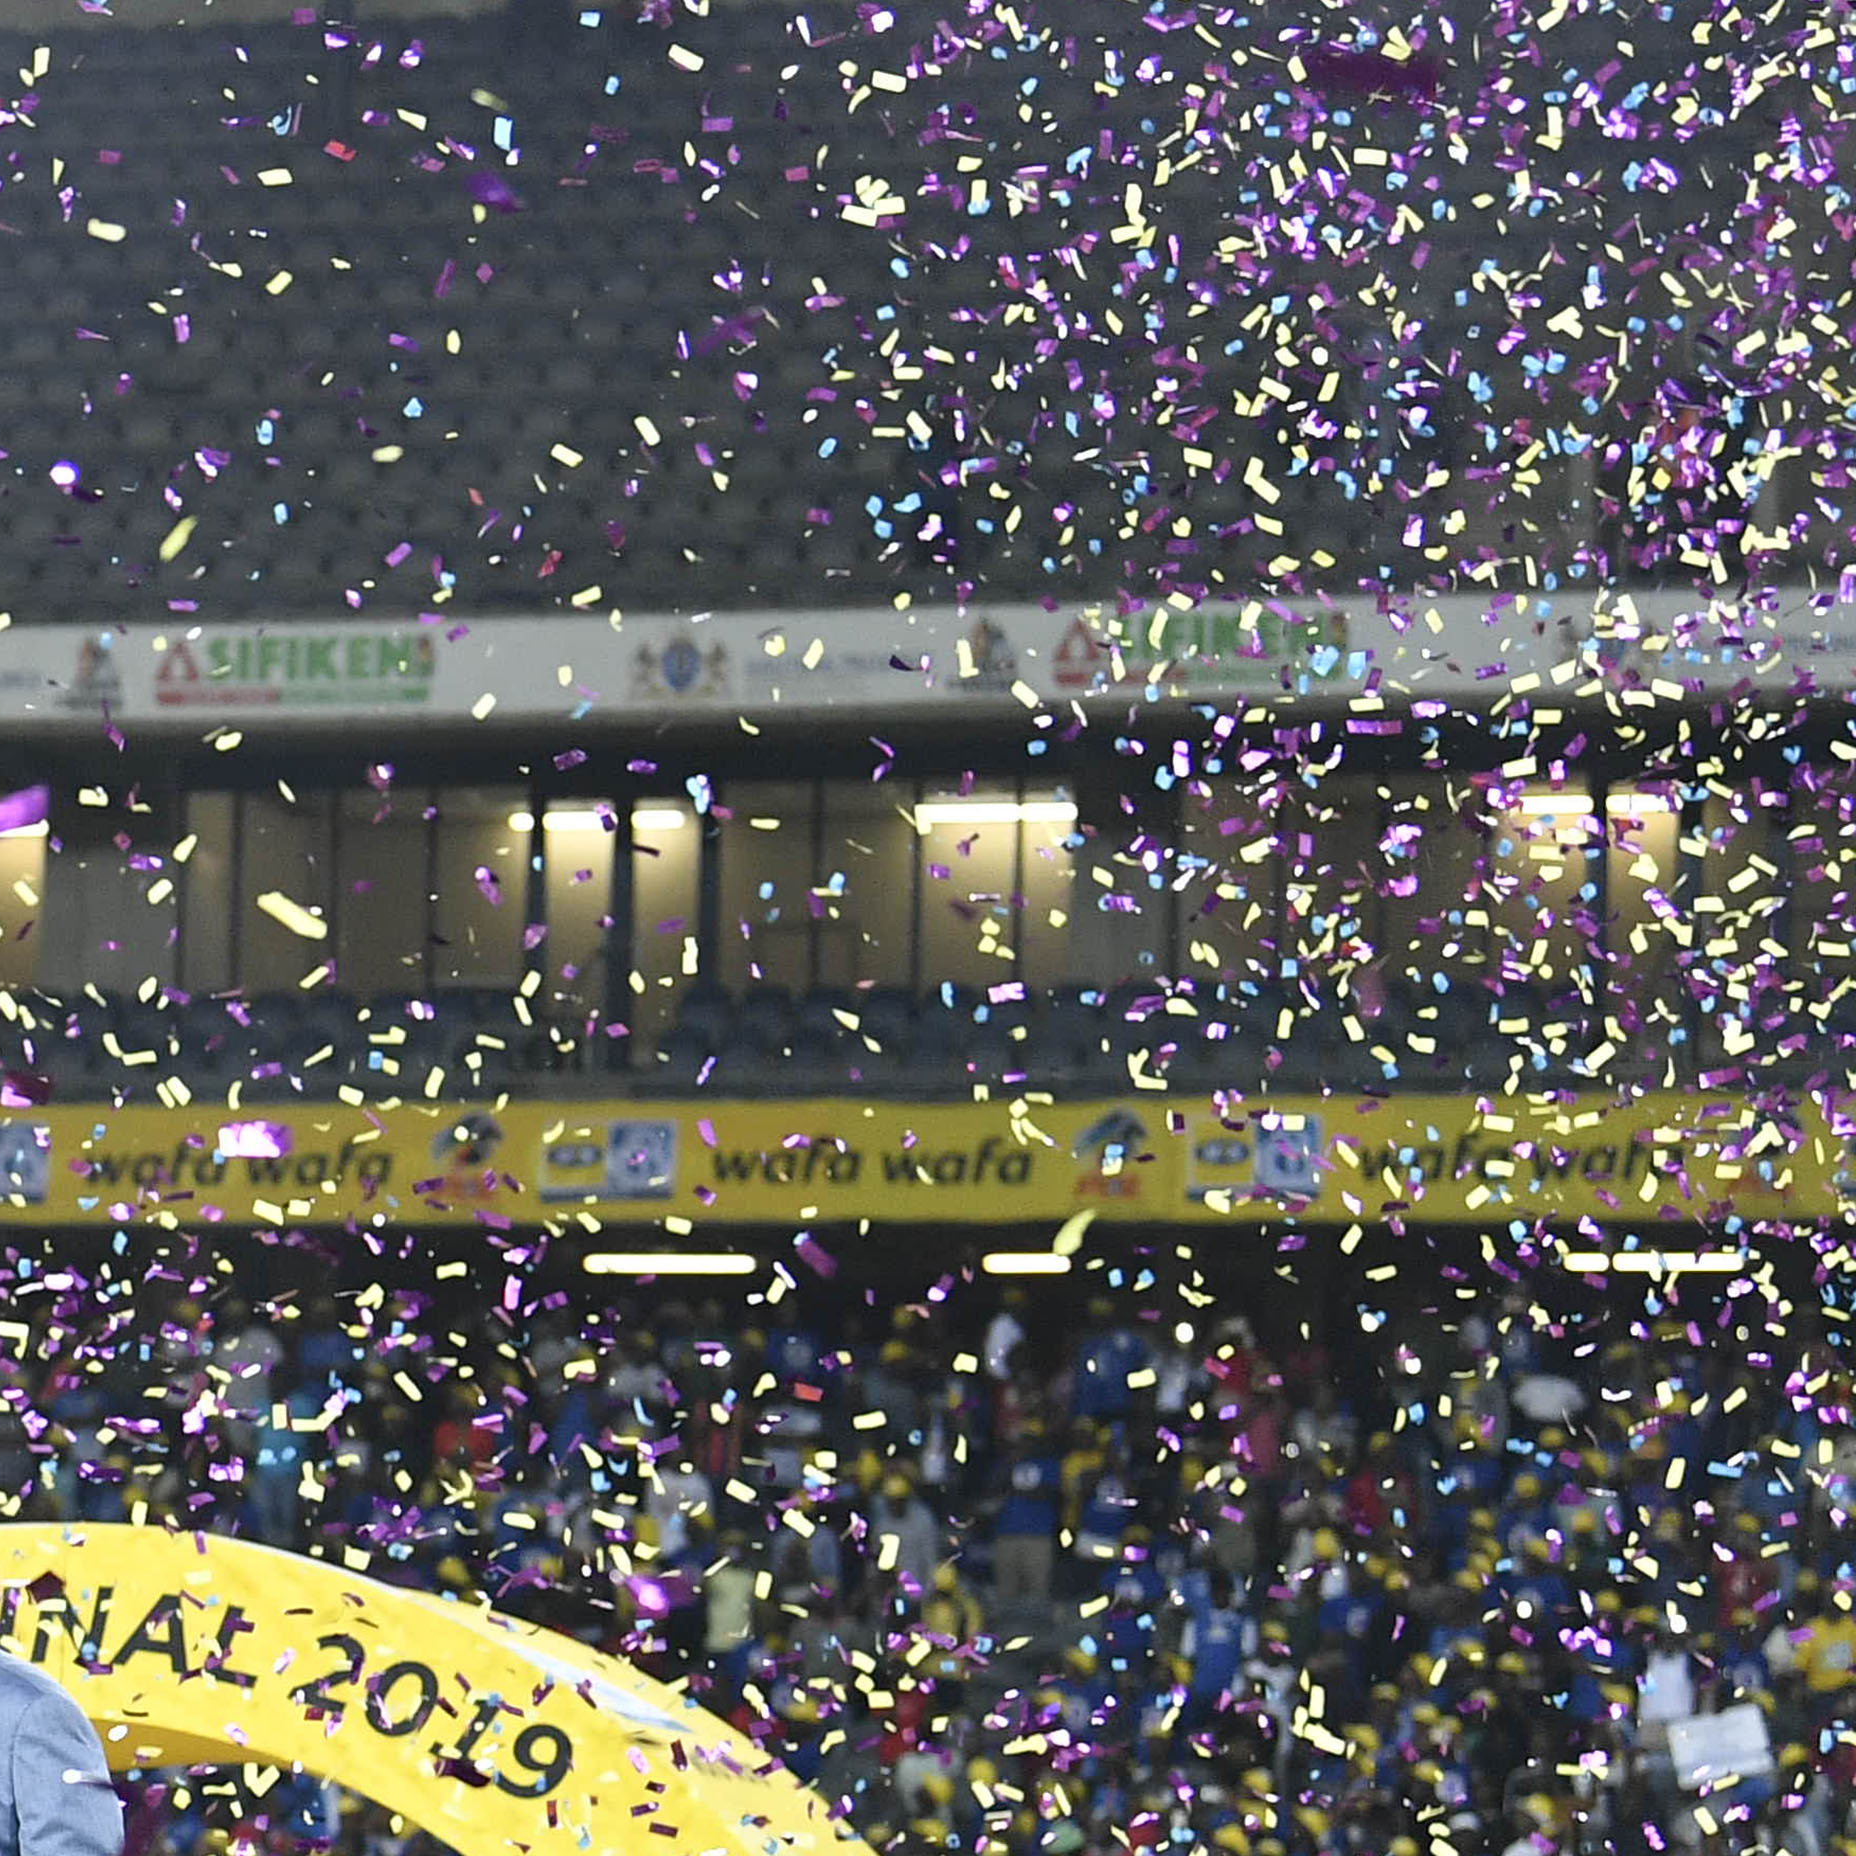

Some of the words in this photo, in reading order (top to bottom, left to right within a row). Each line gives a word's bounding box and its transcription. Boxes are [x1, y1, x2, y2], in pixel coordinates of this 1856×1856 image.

[248, 1139, 394, 1188] wafa
[711, 1136, 862, 1186] wafa
[881, 1135, 1034, 1188] wafa
[290, 1632, 575, 1800] 2019
